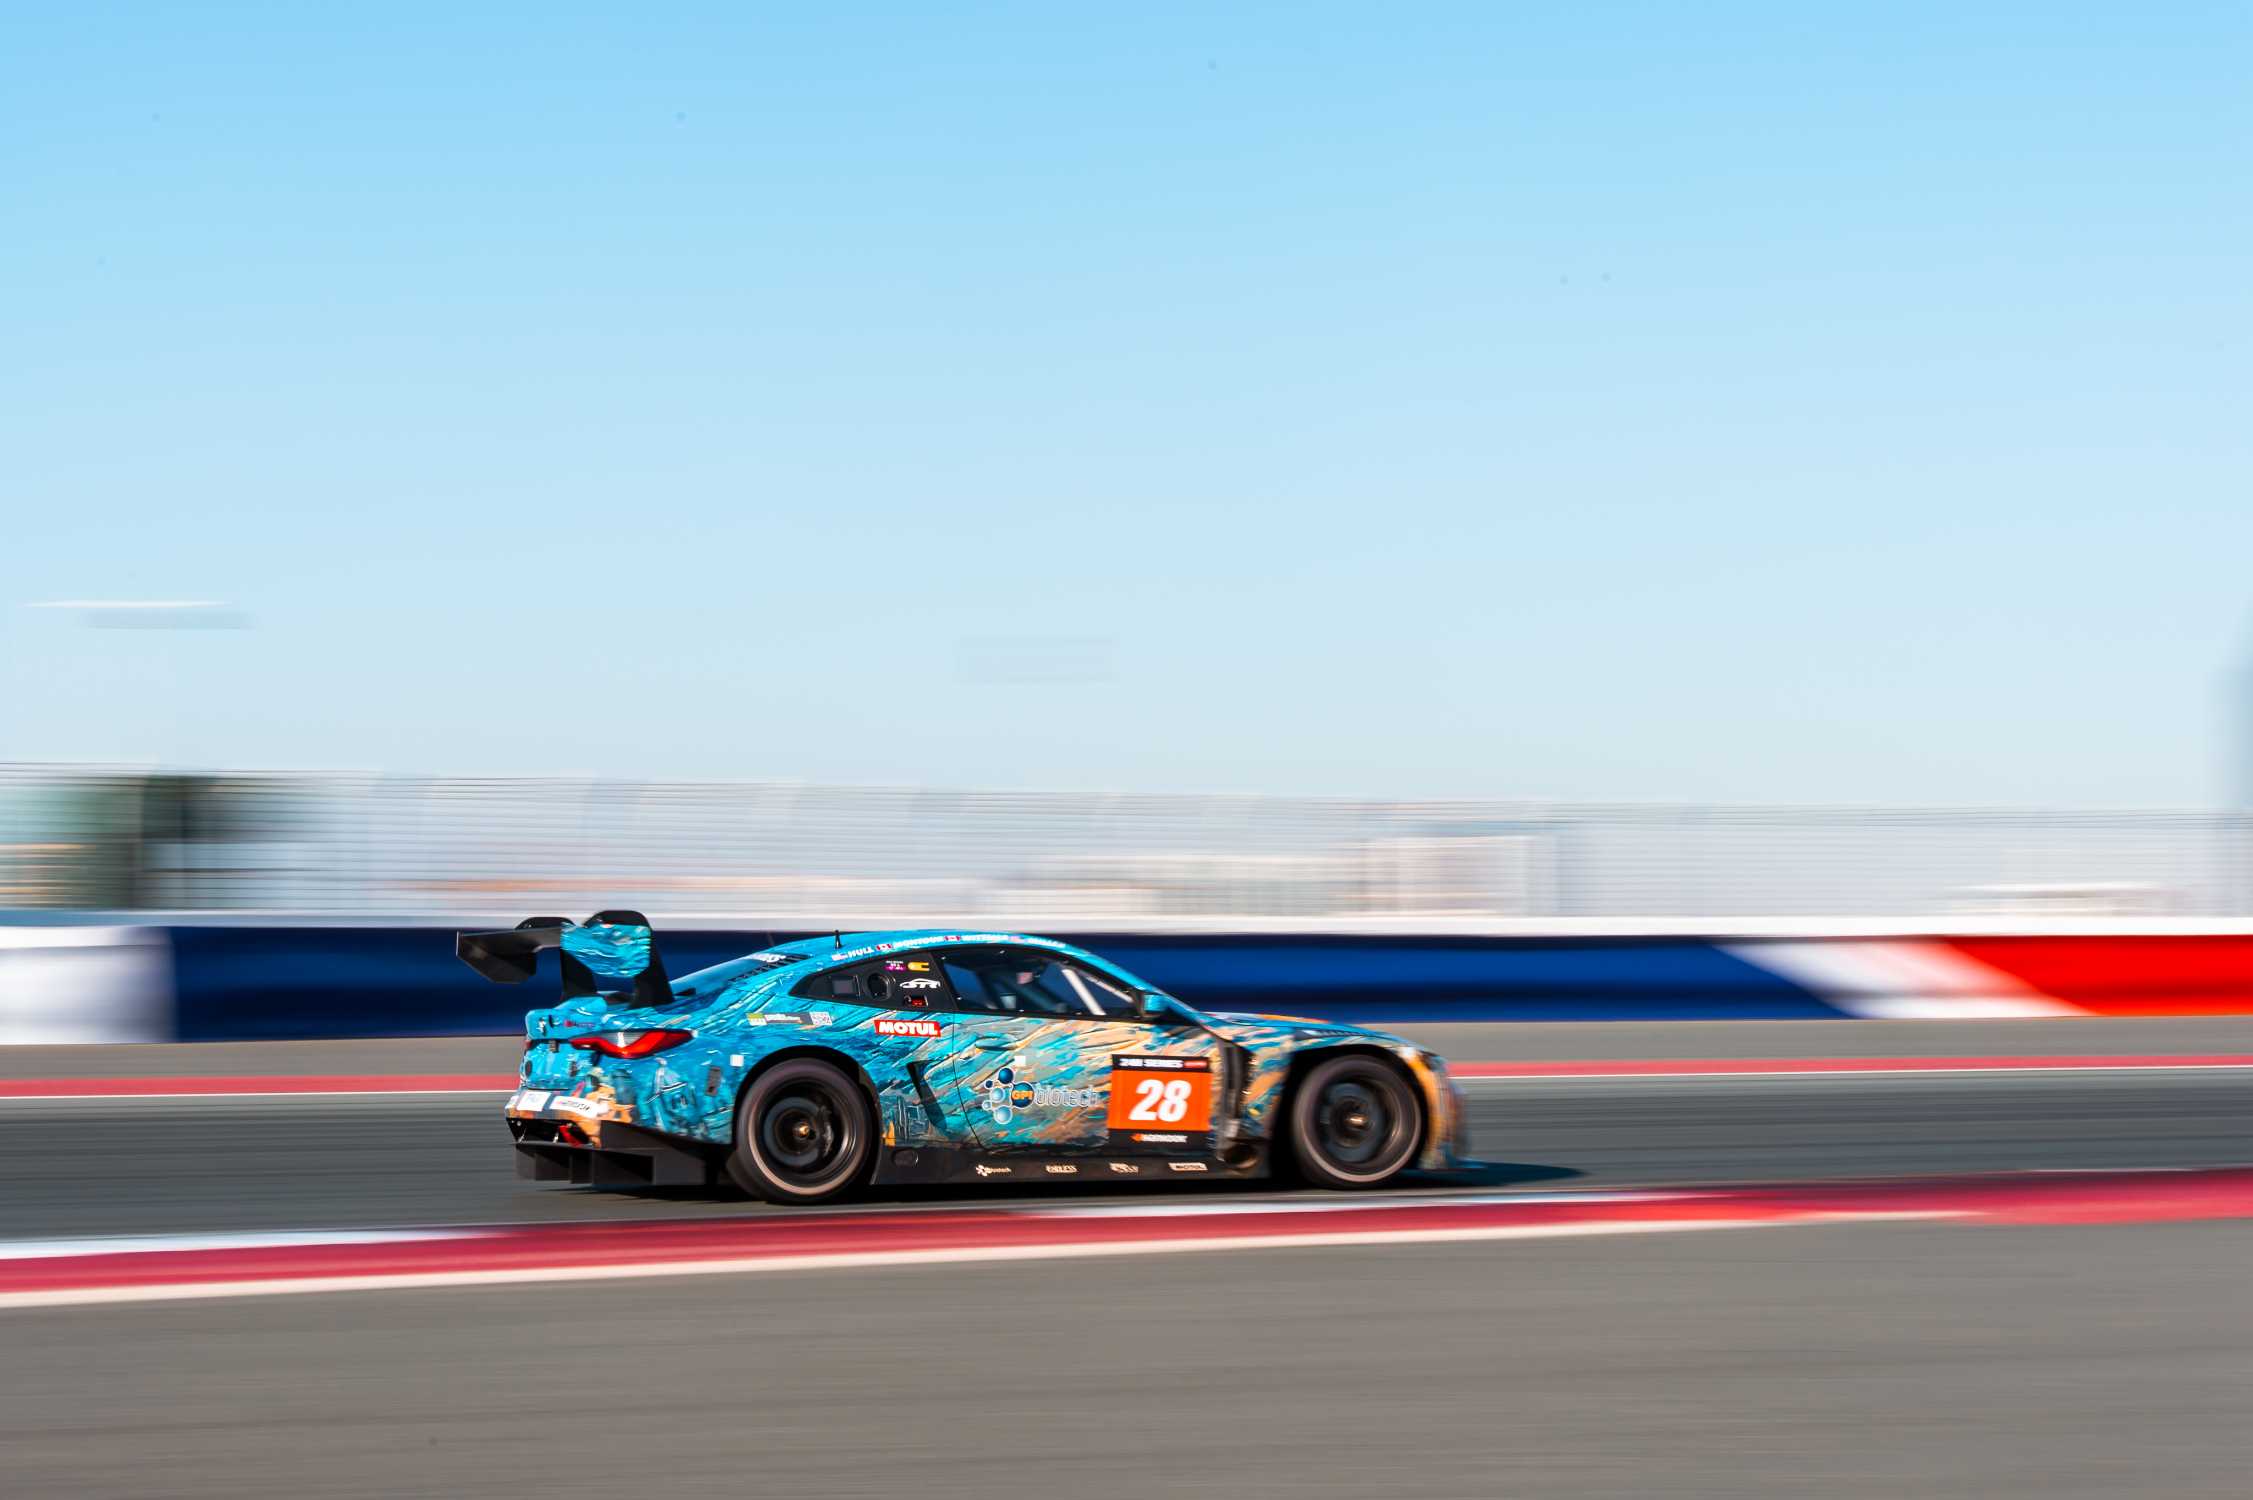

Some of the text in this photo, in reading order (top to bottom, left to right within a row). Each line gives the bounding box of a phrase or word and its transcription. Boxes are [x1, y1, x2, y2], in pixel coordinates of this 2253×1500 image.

[847, 947, 874, 958] HULL
[879, 1021, 938, 1036] MOTUL
[1034, 1083, 1098, 1107] biotech
[1128, 1079, 1192, 1122] 28
